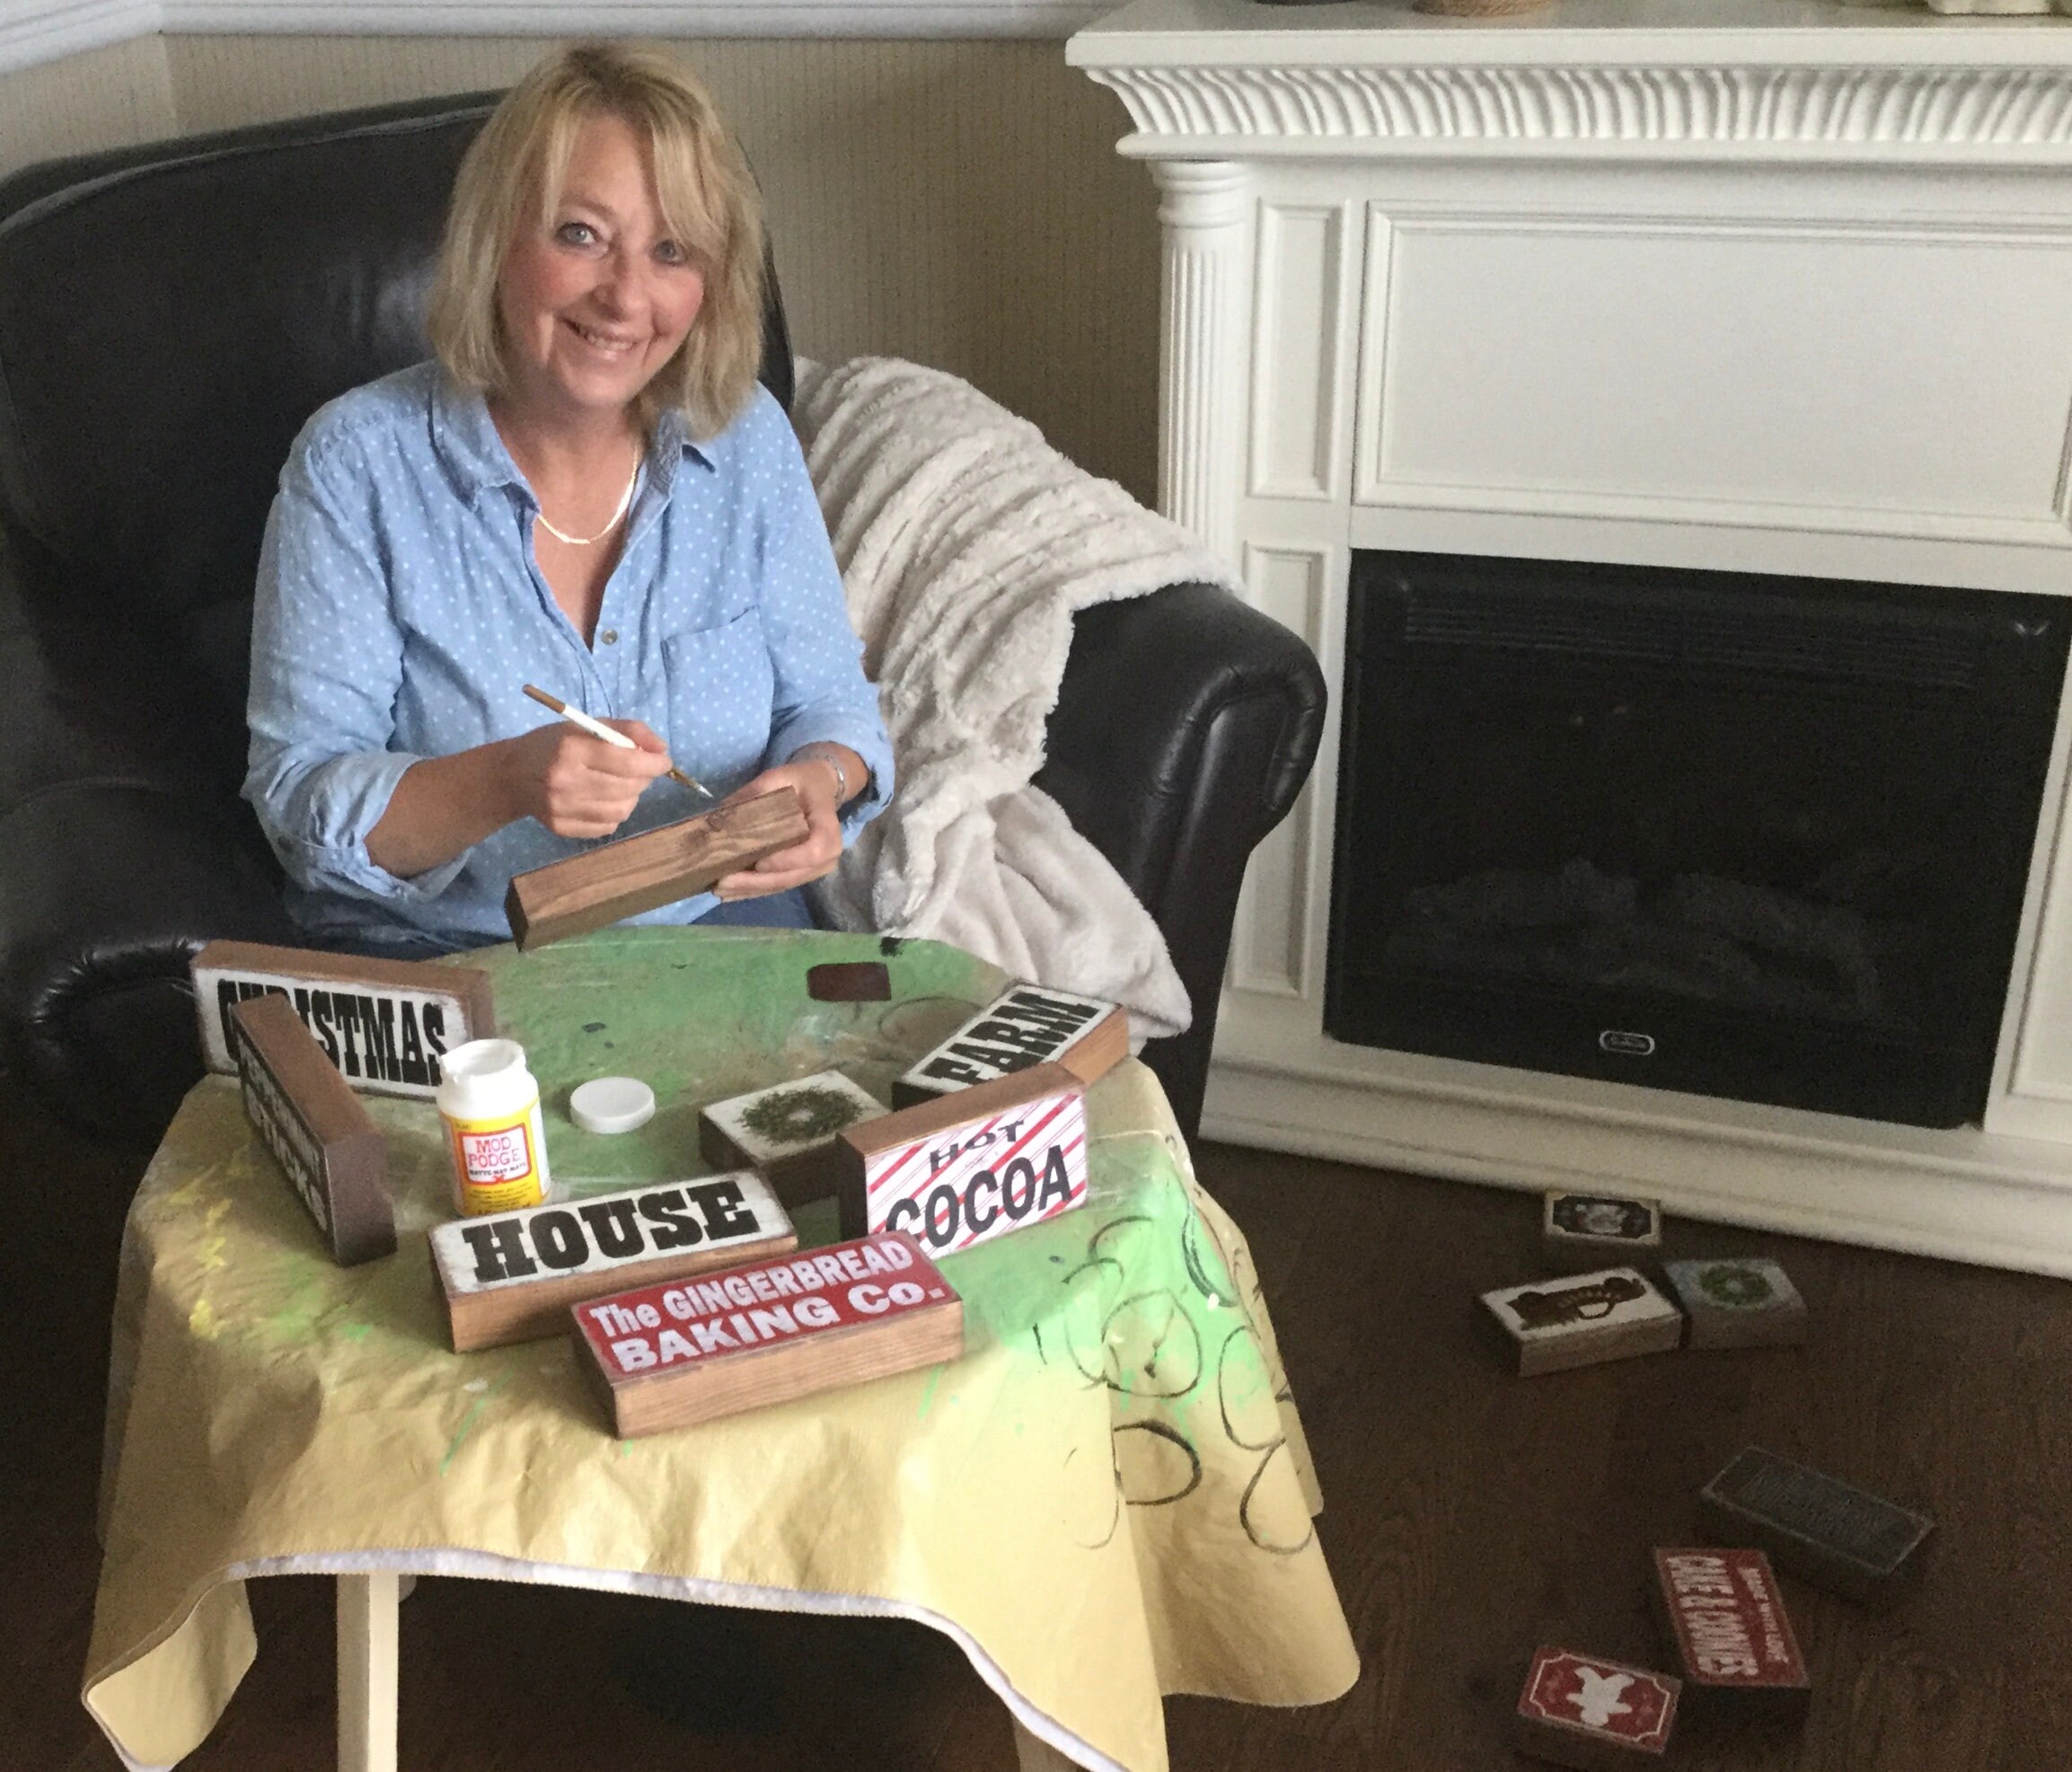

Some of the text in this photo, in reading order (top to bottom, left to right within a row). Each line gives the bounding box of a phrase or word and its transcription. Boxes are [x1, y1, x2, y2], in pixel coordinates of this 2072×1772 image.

[217, 978, 446, 1088] CISTMAS
[920, 992, 1101, 1085] FARM
[468, 1147, 521, 1168] PODGE
[475, 1136, 511, 1153] MOD
[930, 1120, 1024, 1173] HOT
[462, 1181, 762, 1283] HOUSE
[886, 1144, 1072, 1247] COCOA
[589, 1239, 913, 1337] The GINGERBREAD
[612, 1282, 946, 1372] BAKING Co.
